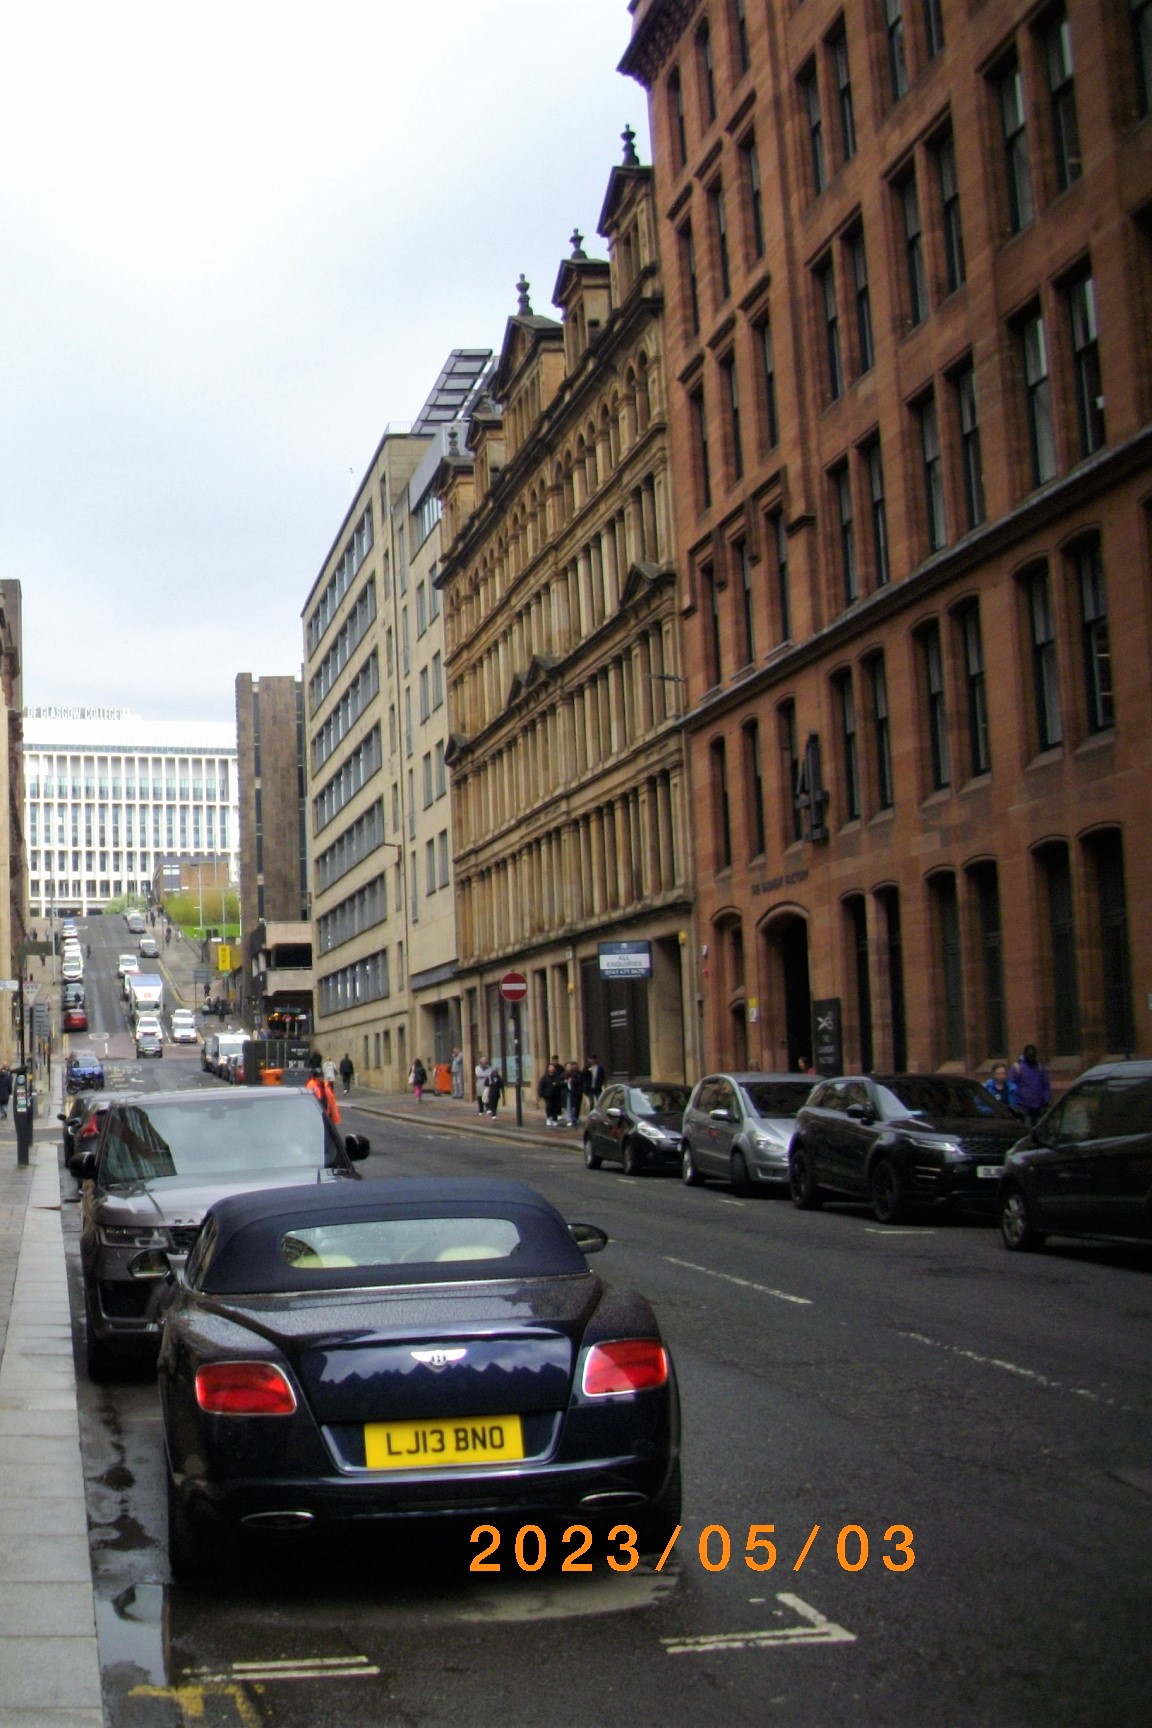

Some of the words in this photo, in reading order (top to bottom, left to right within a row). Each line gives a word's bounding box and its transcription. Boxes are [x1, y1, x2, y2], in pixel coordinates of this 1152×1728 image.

[27, 706, 38, 718] OF
[40, 706, 80, 719] GLASGOW
[85, 707, 121, 720] COLLEGE
[386, 1429, 446, 1456] LJ13
[453, 1425, 505, 1452] BNO
